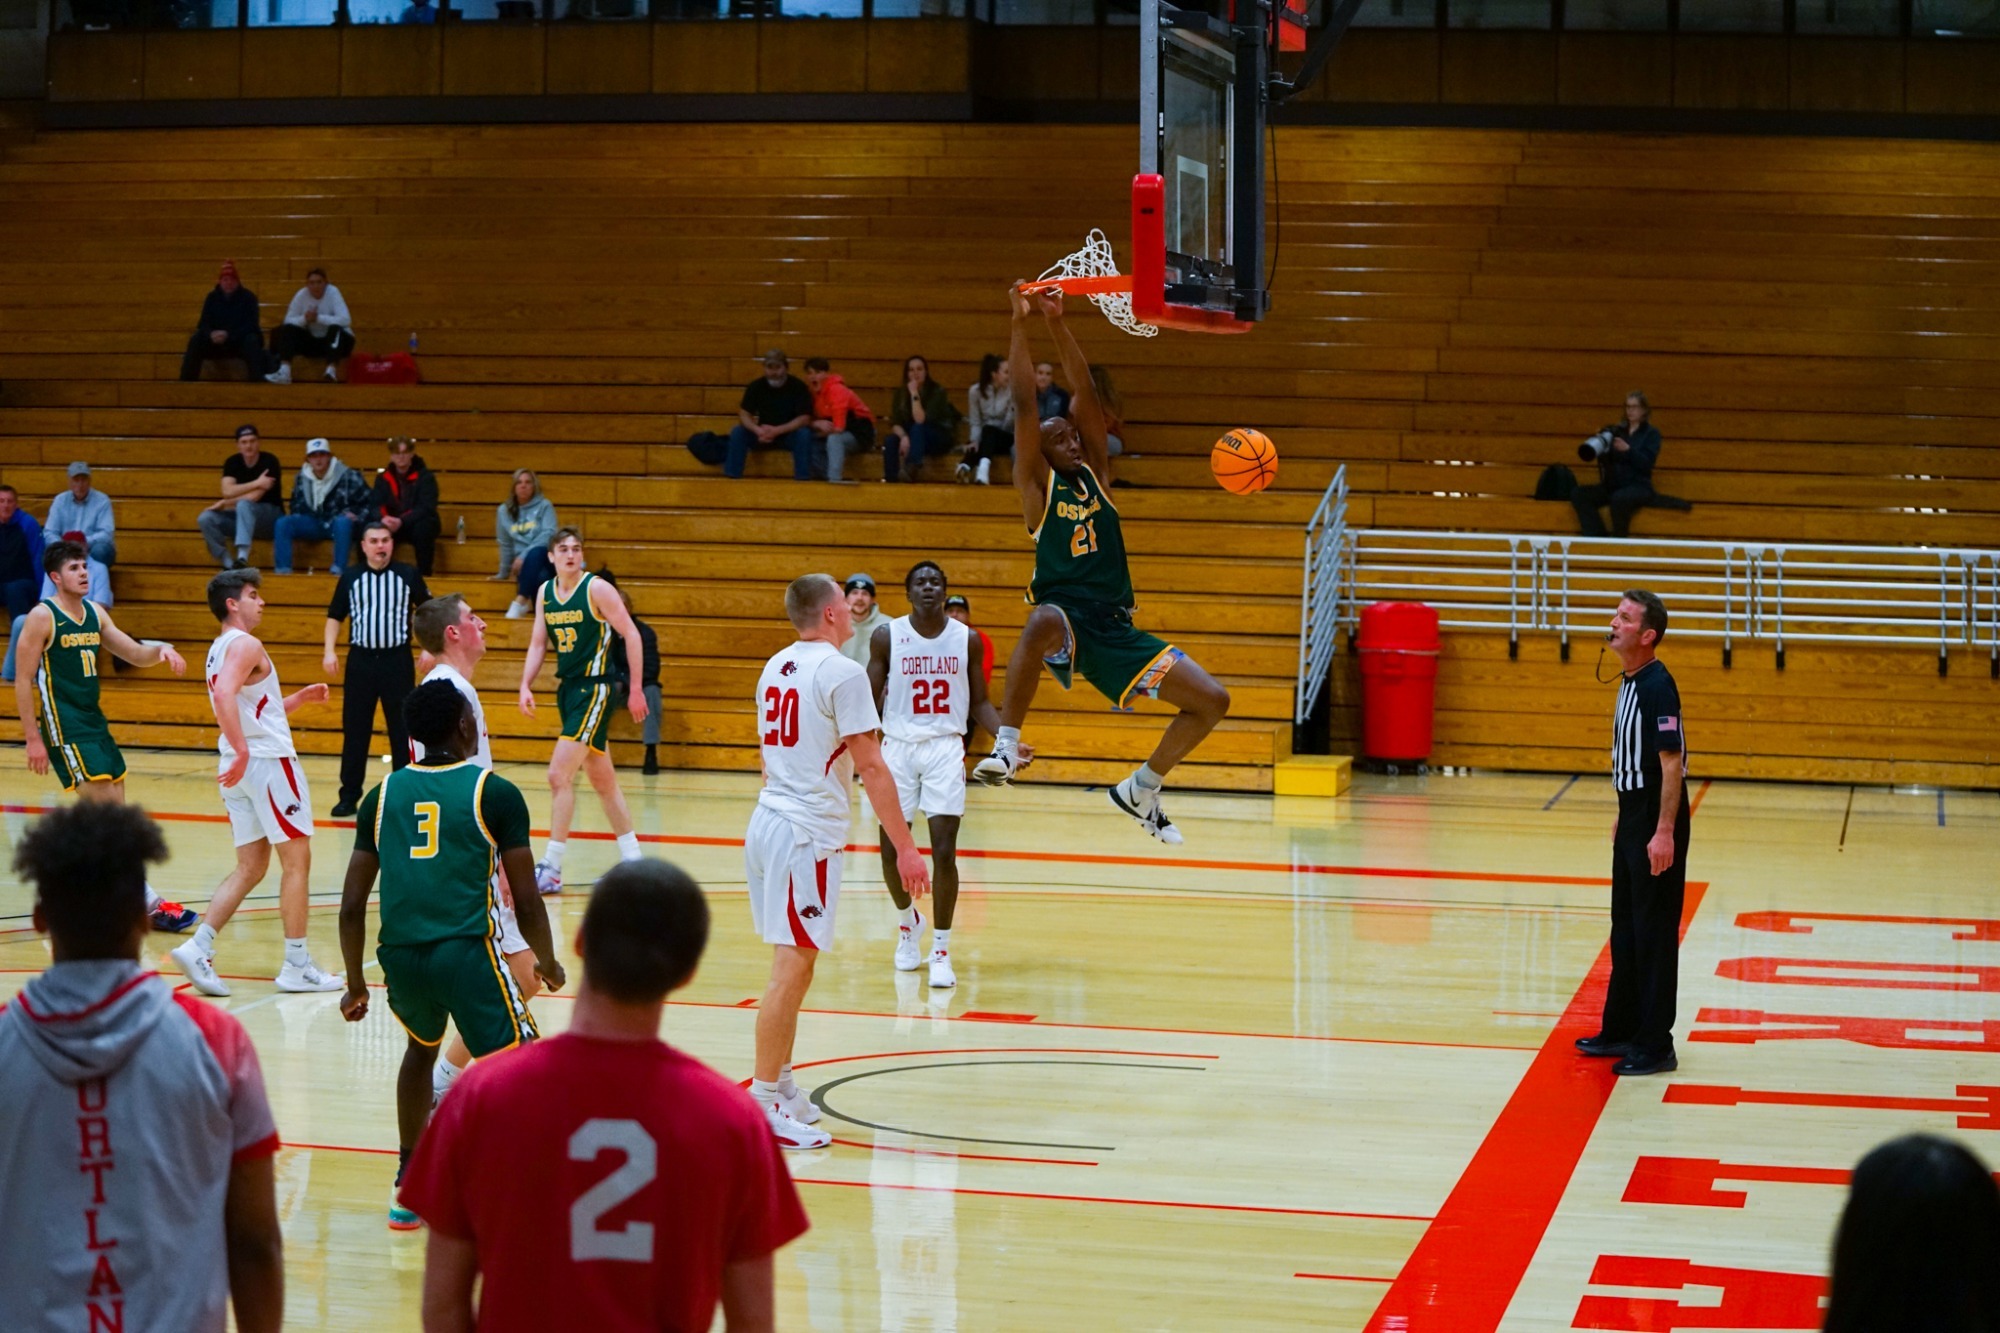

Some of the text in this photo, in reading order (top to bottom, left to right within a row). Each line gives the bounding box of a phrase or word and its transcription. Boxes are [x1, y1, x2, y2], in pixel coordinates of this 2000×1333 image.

[1057, 495, 1101, 520] OSW
[1070, 518, 1098, 557] 21
[554, 627, 577, 653] 22
[80, 649, 97, 677] 11
[902, 656, 959, 675] CORTLAND
[912, 678, 950, 714] 22
[764, 686, 799, 747] 20
[410, 801, 440, 859] 3
[568, 1118, 657, 1263] 2
